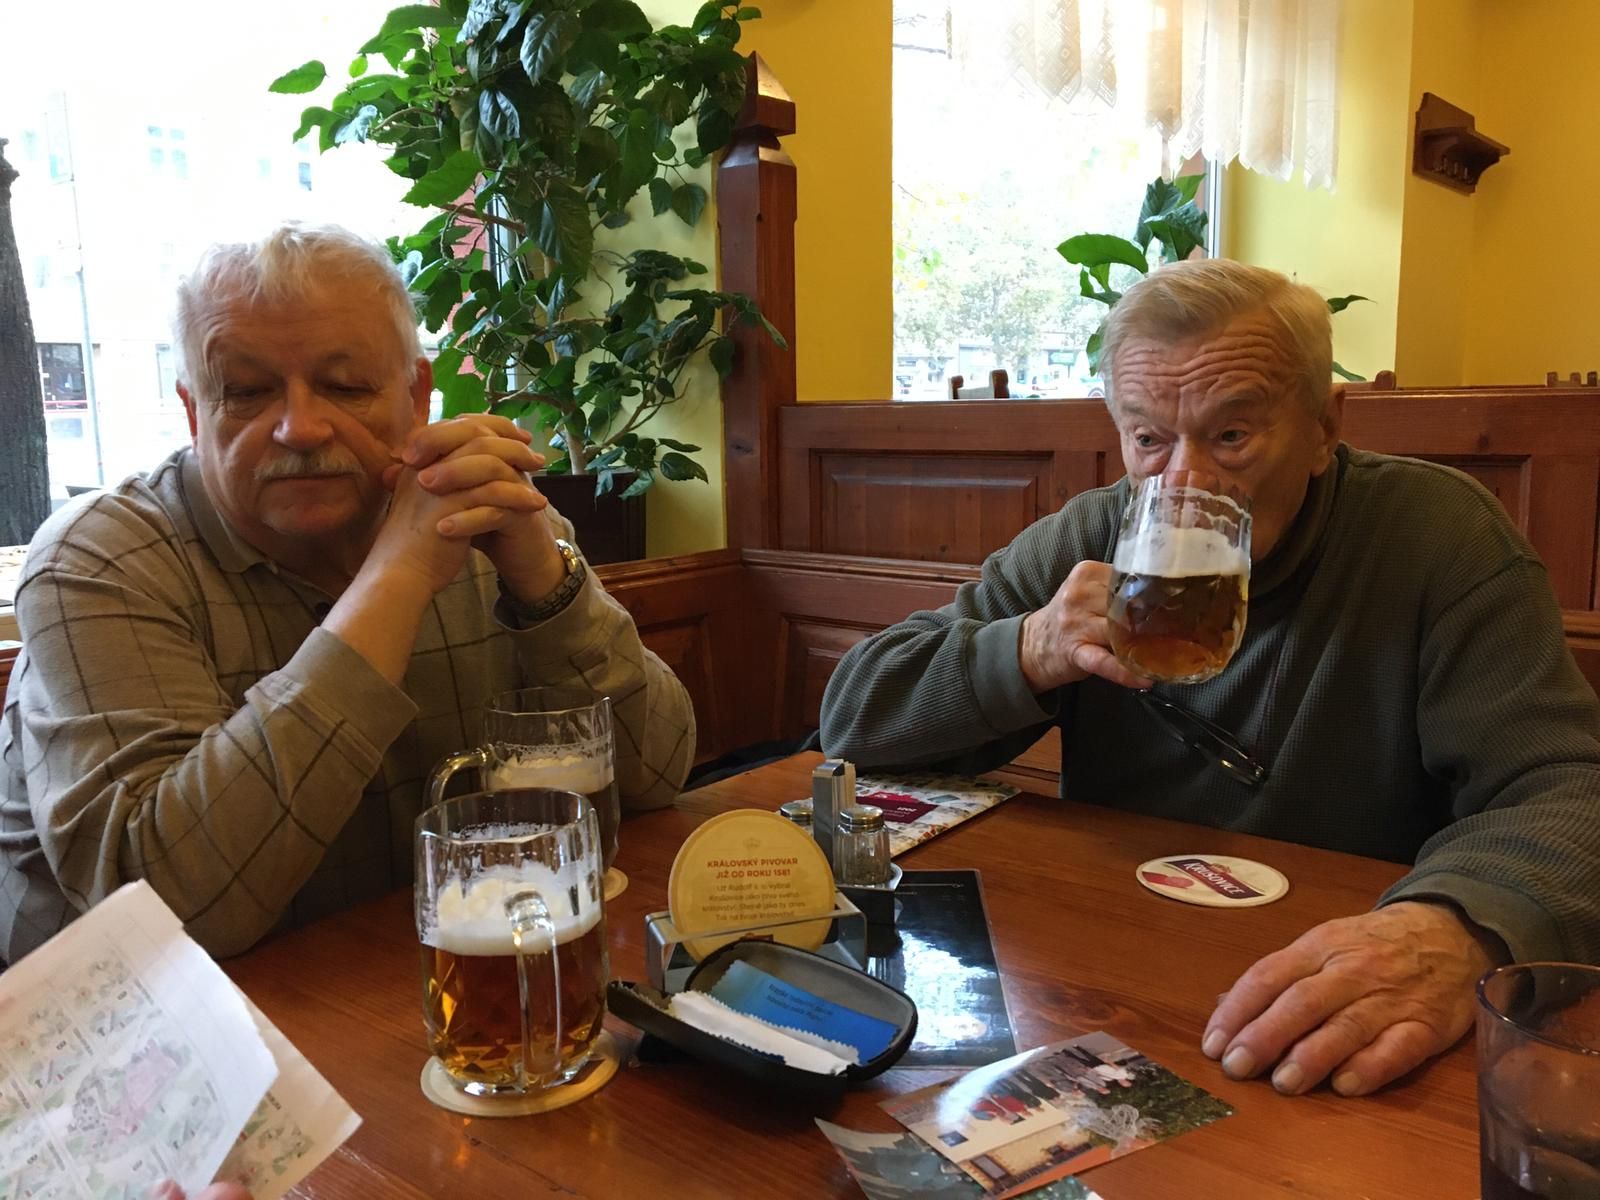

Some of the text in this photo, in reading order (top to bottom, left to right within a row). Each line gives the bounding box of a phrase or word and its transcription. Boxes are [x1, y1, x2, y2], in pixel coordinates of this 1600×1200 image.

[707, 857, 798, 868] KRÁLOVSKÝ PIVOVAR
[716, 870, 729, 879] JIŽ
[731, 870, 744, 878] OD
